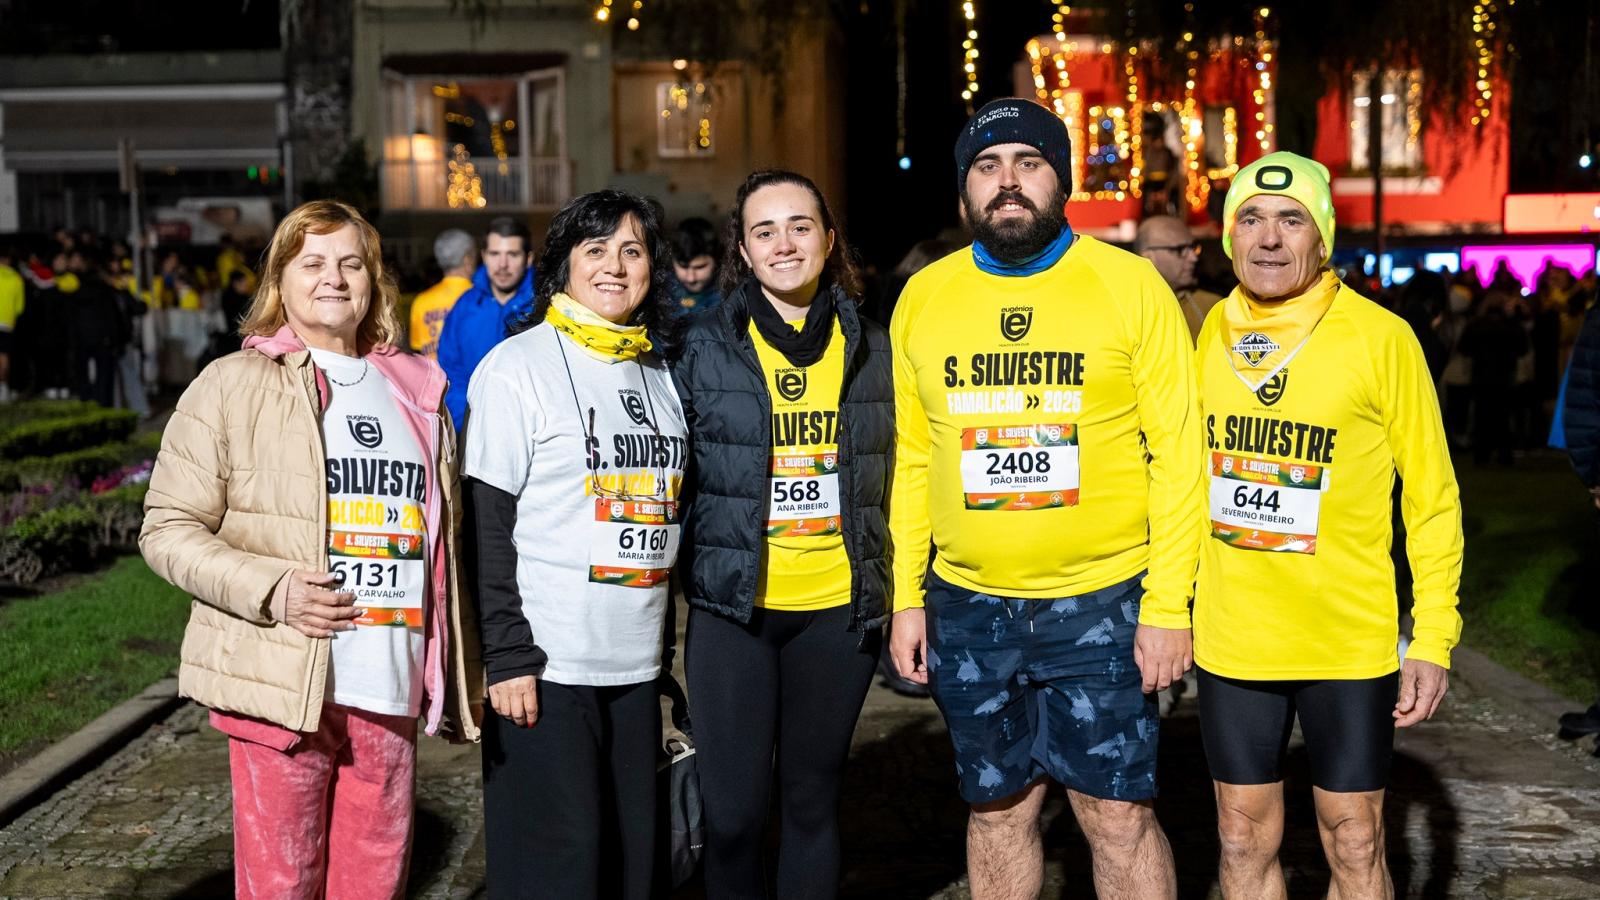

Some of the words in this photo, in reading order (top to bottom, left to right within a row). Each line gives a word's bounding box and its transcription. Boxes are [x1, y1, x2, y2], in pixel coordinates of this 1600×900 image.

[944, 355, 965, 388] S.
[971, 351, 1085, 387] SILVESTRE
[946, 387, 1024, 415] FAMALICÃO
[1043, 390, 1082, 415] 2025
[1207, 414, 1220, 450] S.
[1225, 414, 1337, 464] SILVESTRE
[585, 435, 608, 470] S.
[986, 451, 1051, 475] 2408
[327, 458, 426, 504] SILVESTR
[773, 480, 820, 502] 568
[990, 475, 1012, 486] JOÃO
[1014, 475, 1048, 484] RIBEIRO
[797, 502, 829, 510] RIBEIRO
[1233, 485, 1280, 513] 644
[1221, 507, 1257, 519] SEVERINO
[1259, 513, 1294, 524] RIBEIRO
[619, 527, 668, 551] 6160
[617, 551, 644, 560] MARIA
[646, 552, 665, 560] RIBEIRO
[331, 561, 398, 588] 6131
[358, 589, 405, 598] CARVALHO
